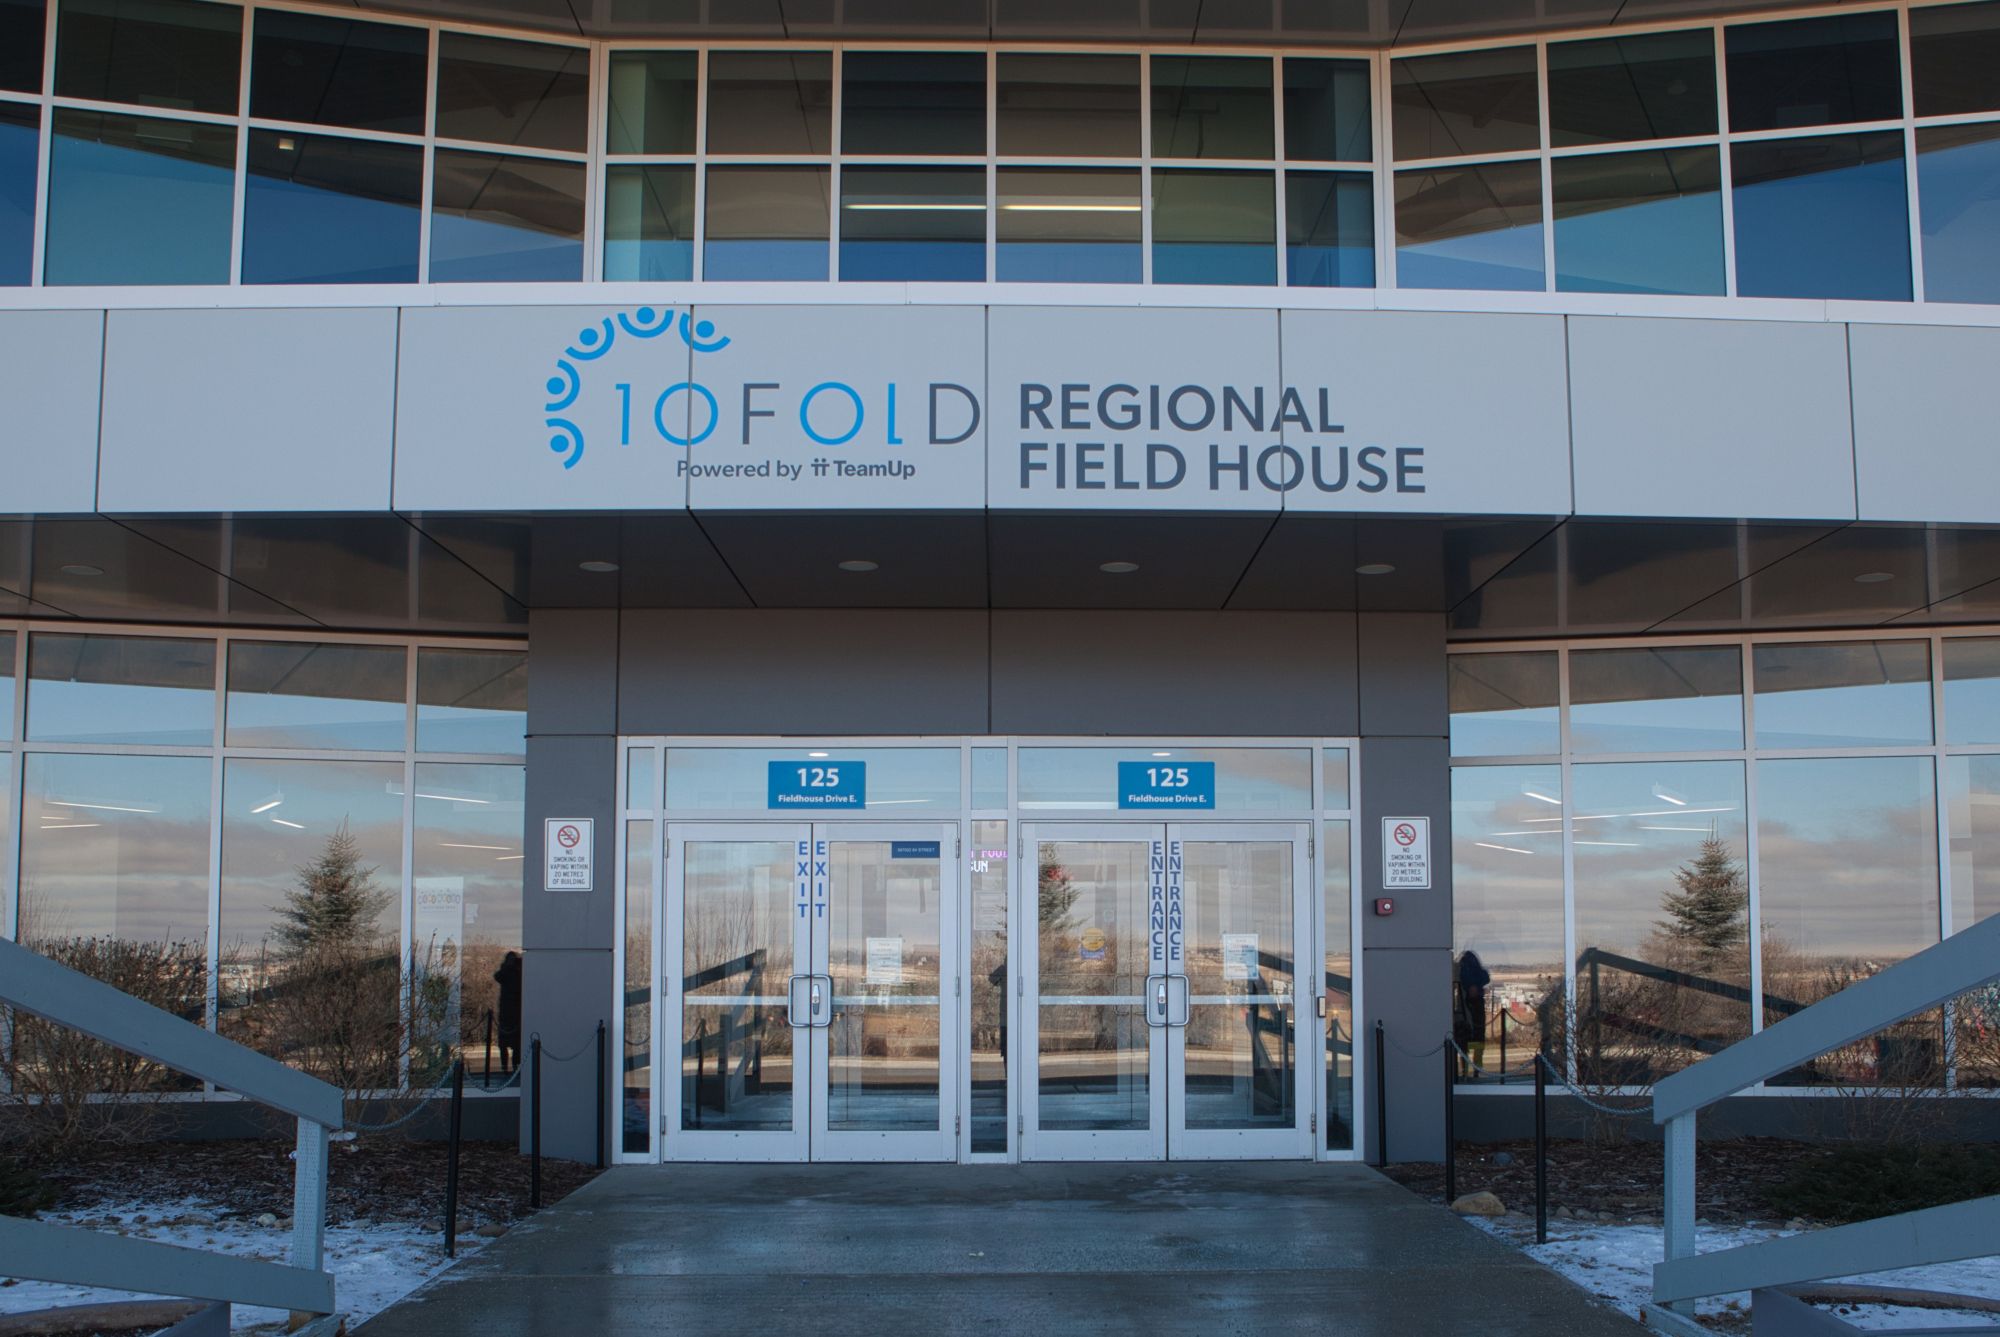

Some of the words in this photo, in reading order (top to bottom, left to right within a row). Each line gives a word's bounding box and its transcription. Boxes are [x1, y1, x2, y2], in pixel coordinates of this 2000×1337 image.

[1020, 383, 1345, 433] REGIONAL
[677, 460, 771, 478] Powered
[776, 460, 803, 481] by
[833, 460, 916, 480] TeamUp
[1020, 442, 1187, 490] FIELD
[1209, 444, 1426, 493] HOUSE
[778, 794, 824, 803] Fieldhouse
[825, 794, 848, 803] Drive
[849, 794, 857, 803] E.
[797, 768, 840, 787] 125
[1128, 794, 1174, 803] Fieldhouse
[1175, 794, 1198, 803] Drive
[1199, 794, 1207, 803] E.
[1147, 768, 1189, 787] 125
[798, 841, 808, 918] EXIT
[815, 841, 826, 918] EXIT
[1152, 841, 1164, 961] ENTRANCE
[1169, 841, 1182, 961] ENTRANCE
